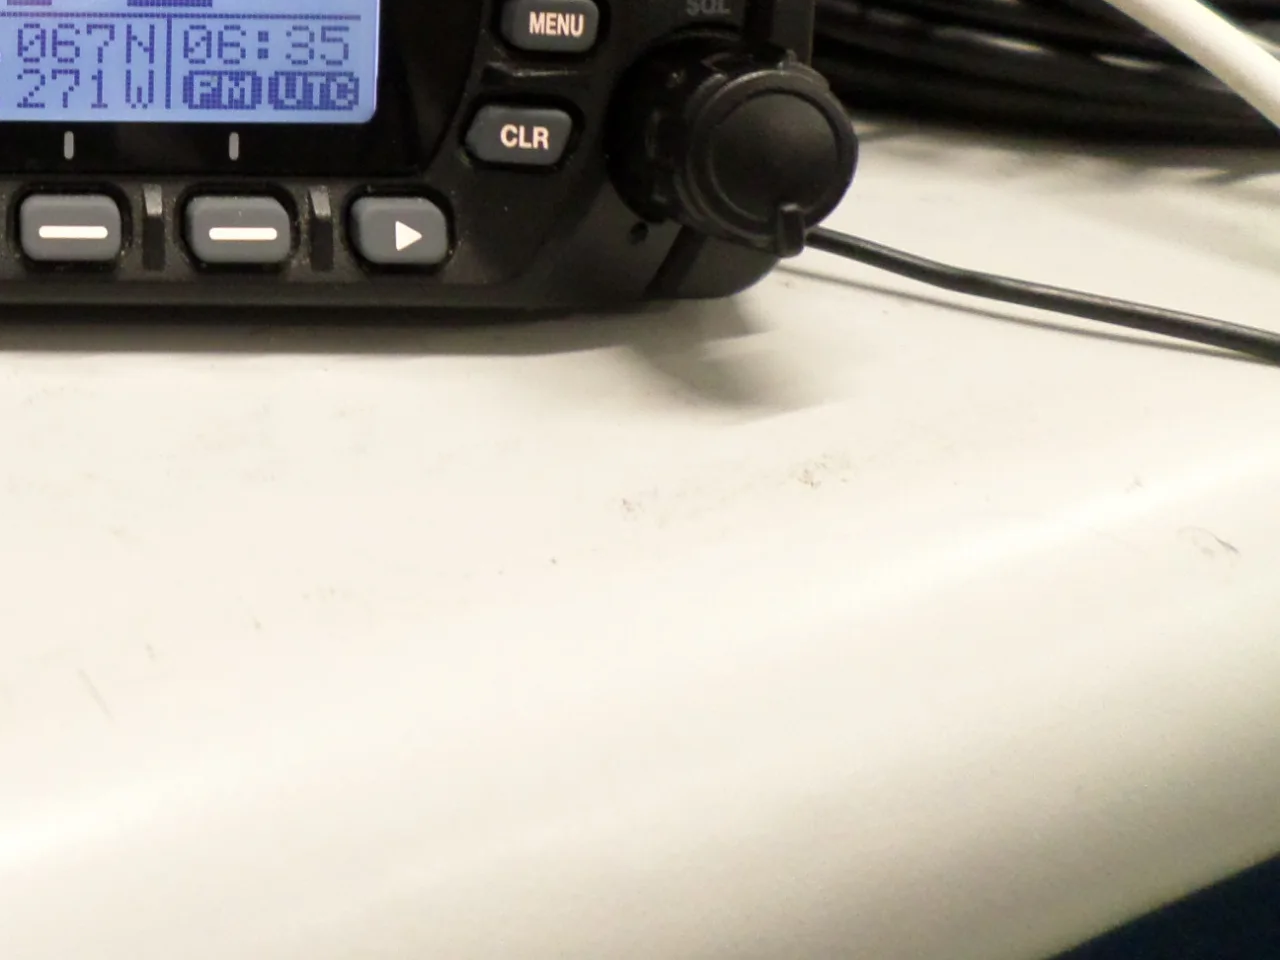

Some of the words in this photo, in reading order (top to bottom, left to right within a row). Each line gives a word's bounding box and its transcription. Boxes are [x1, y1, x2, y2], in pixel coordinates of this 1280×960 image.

[528, 11, 584, 37] MENU
[182, 24, 351, 66] 06:35
[276, 74, 357, 109] UTC
[499, 124, 550, 150] CLR
